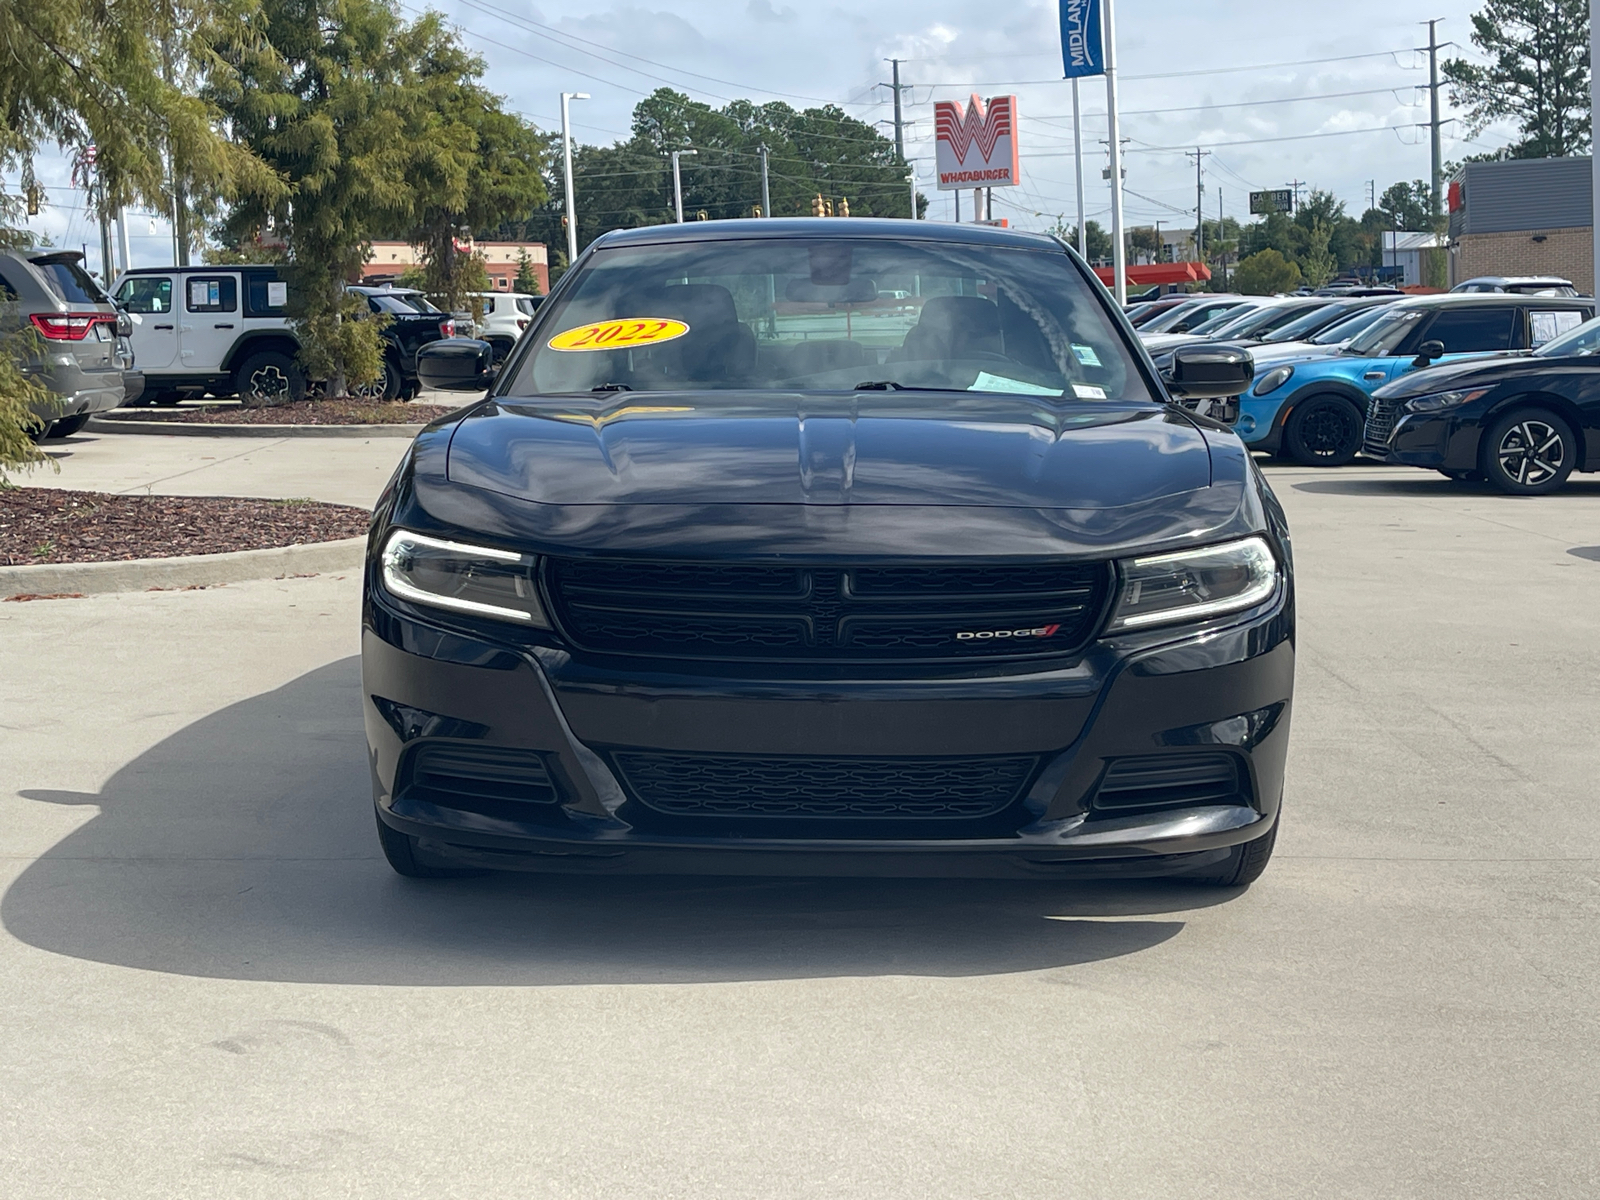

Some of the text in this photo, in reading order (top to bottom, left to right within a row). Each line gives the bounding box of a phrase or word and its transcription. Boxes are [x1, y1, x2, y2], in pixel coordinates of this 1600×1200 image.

[940, 168, 1010, 184] WHATABURGER
[1251, 192, 1288, 203] CABER
[569, 322, 668, 347] 2022
[956, 627, 1047, 640] DODGE
